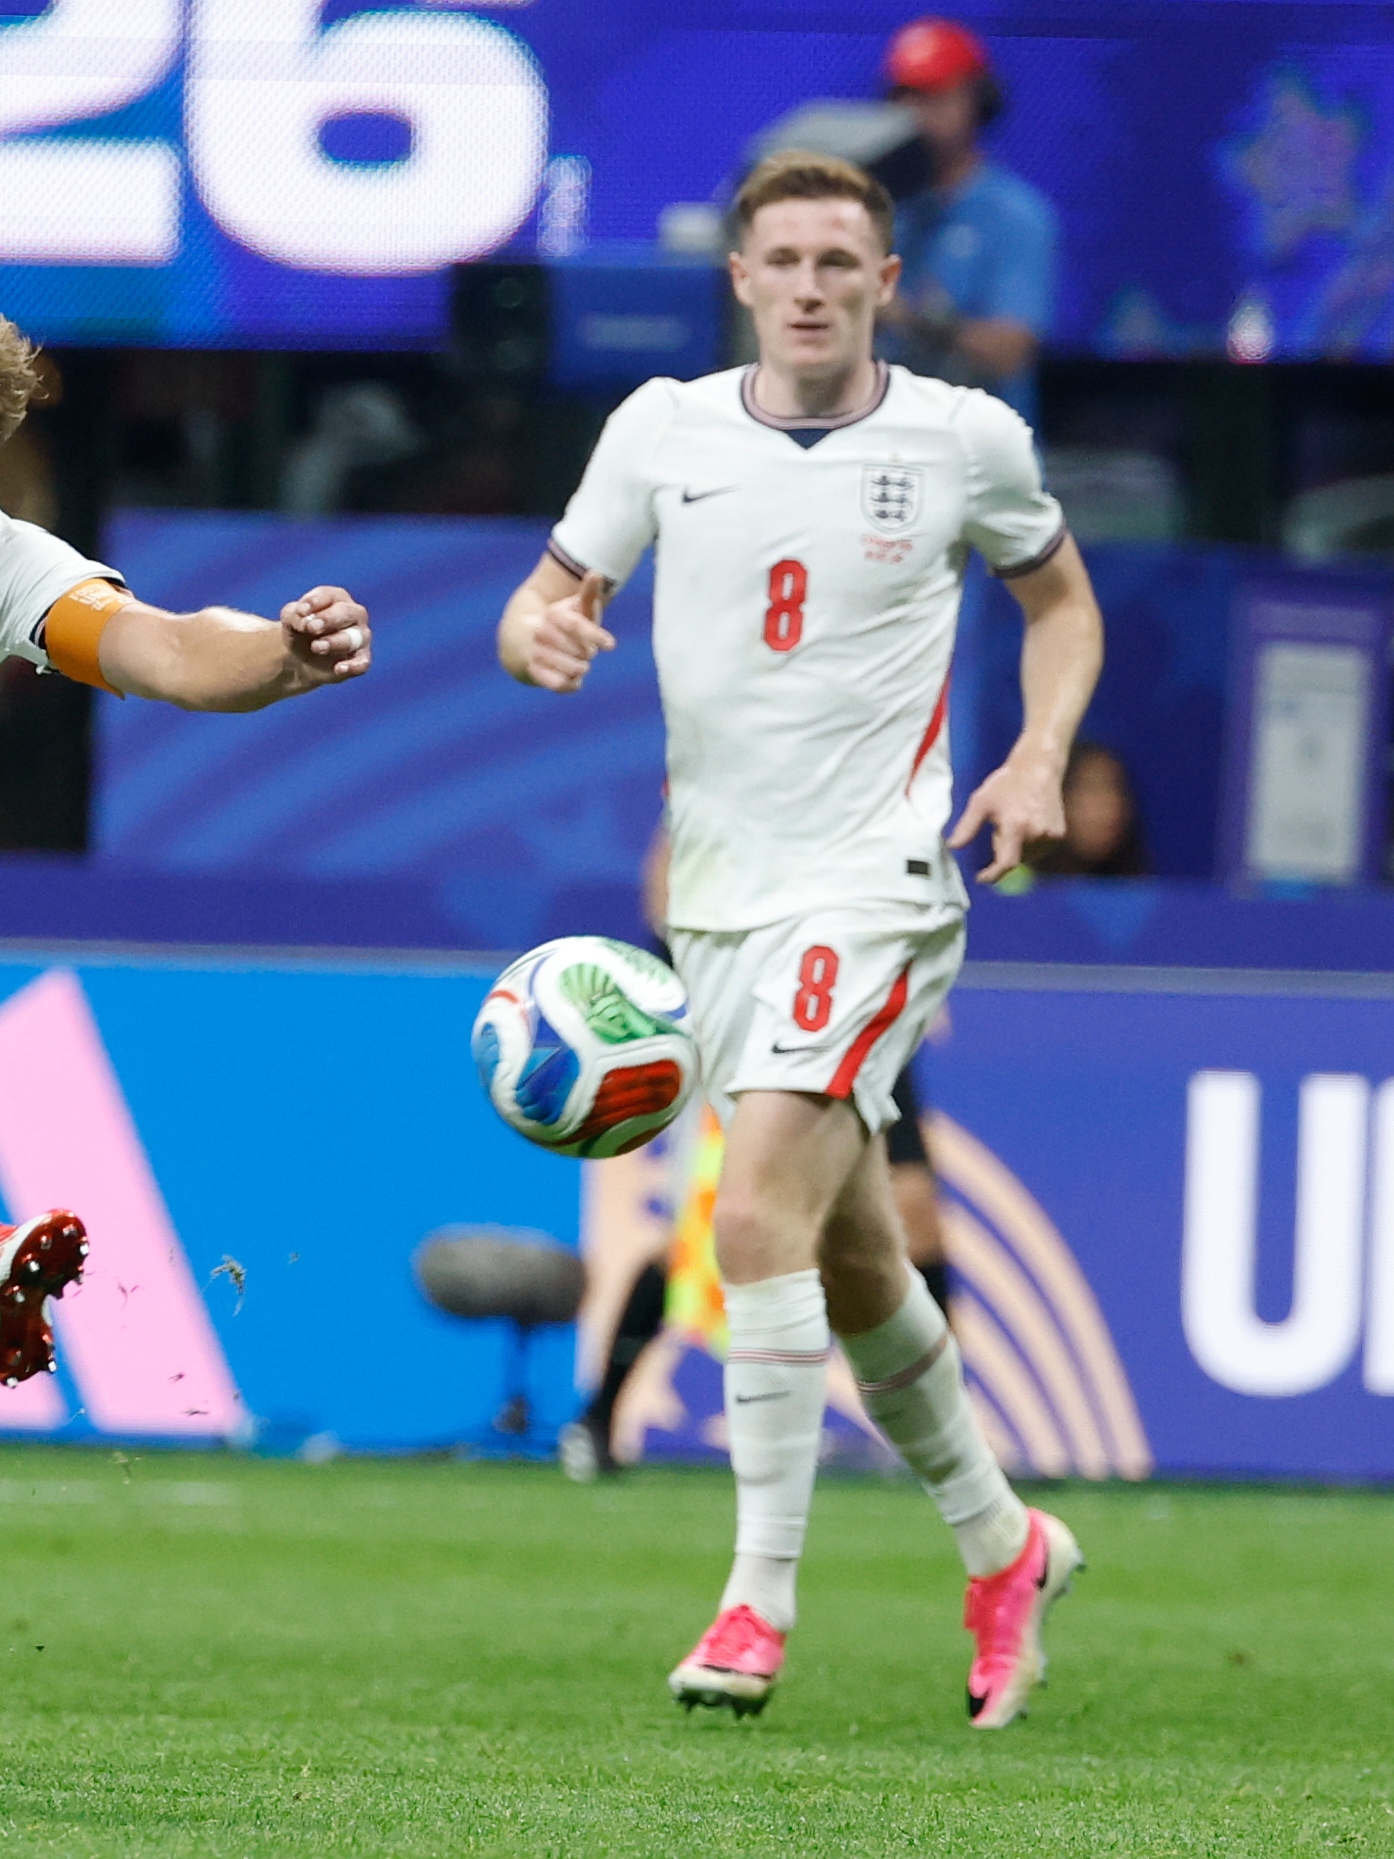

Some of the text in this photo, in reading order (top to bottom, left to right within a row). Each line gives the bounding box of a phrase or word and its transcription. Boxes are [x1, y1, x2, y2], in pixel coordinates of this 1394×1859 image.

[763, 558, 808, 652] 8
[792, 945, 839, 1032] 8
[1180, 1068, 1394, 1397] U
